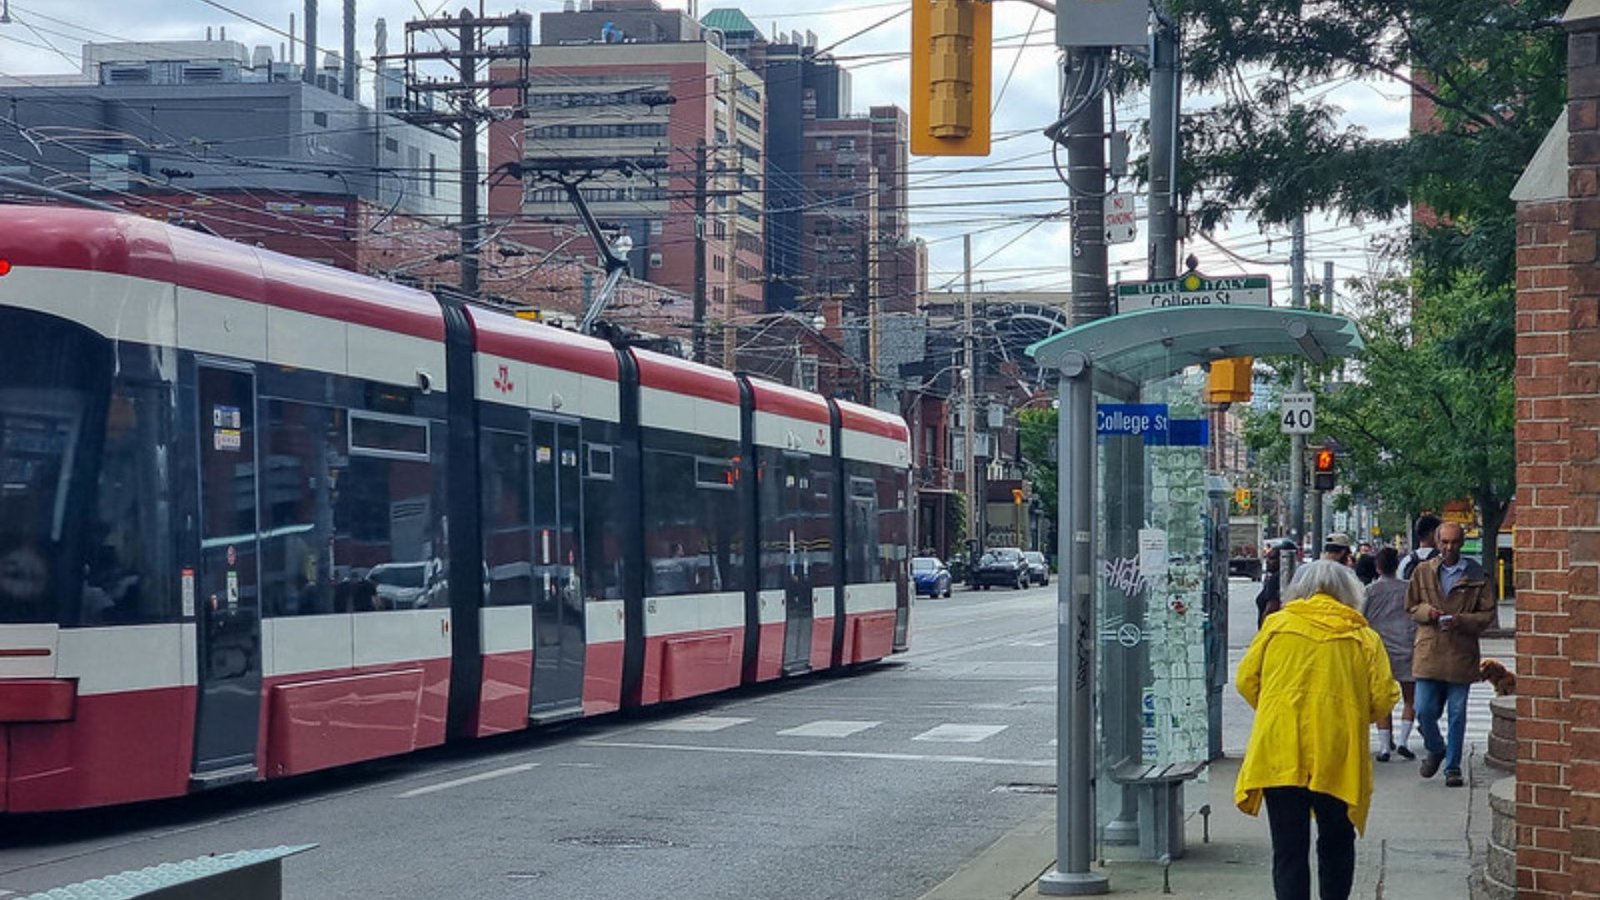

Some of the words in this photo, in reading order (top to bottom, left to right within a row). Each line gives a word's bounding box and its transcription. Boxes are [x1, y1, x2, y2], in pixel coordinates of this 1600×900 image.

[1113, 198, 1124, 208] NO
[1137, 282, 1180, 295] LITTLE
[1204, 278, 1247, 291] ITALY
[1151, 293, 1211, 307] College
[1216, 291, 1231, 305] St
[1096, 410, 1150, 435] College
[1154, 413, 1169, 431] St
[1283, 409, 1313, 429] 40
